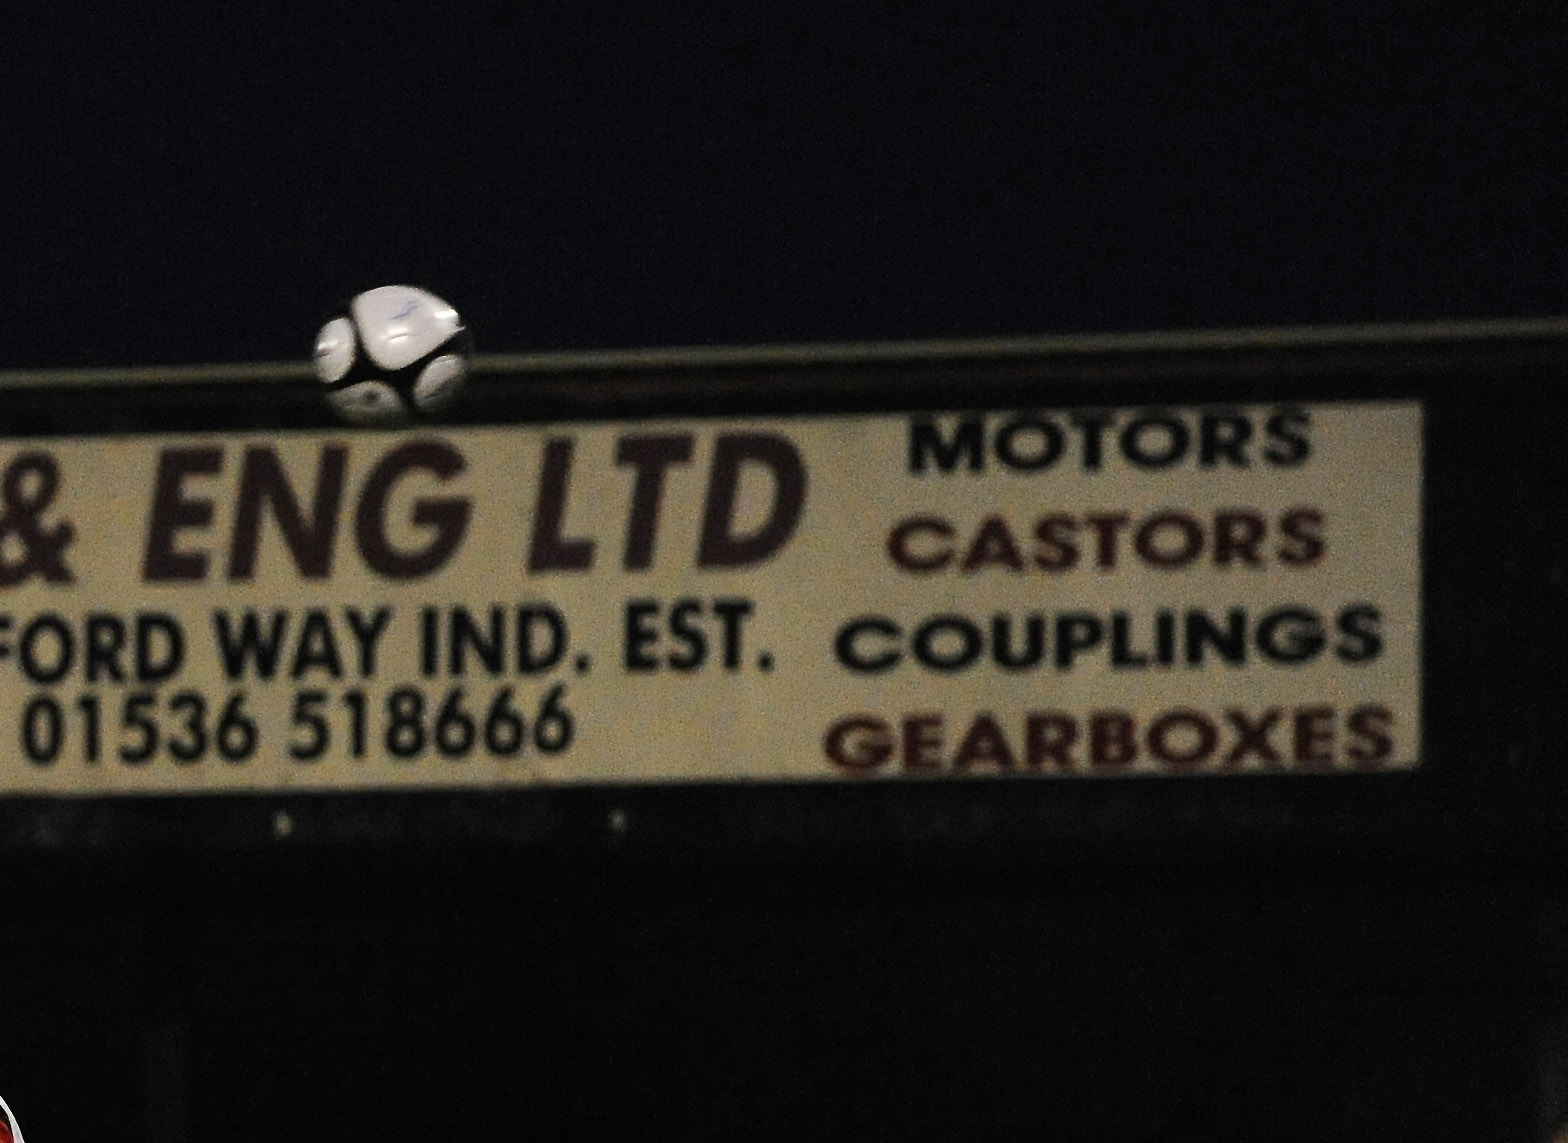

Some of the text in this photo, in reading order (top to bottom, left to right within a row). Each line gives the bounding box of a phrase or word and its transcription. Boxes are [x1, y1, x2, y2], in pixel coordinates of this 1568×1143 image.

[907, 407, 1311, 474] MOTORS
[143, 438, 473, 583] ENG
[526, 430, 809, 574] LTD
[887, 508, 1327, 575] CASTORS
[217, 606, 390, 681] WAY
[421, 603, 590, 677] IND.
[625, 600, 774, 673] EST.
[834, 602, 1383, 673] COUPLINGS
[22, 687, 260, 765] 01536
[289, 686, 576, 760] 518666
[824, 704, 1395, 774] GEARBOXES
